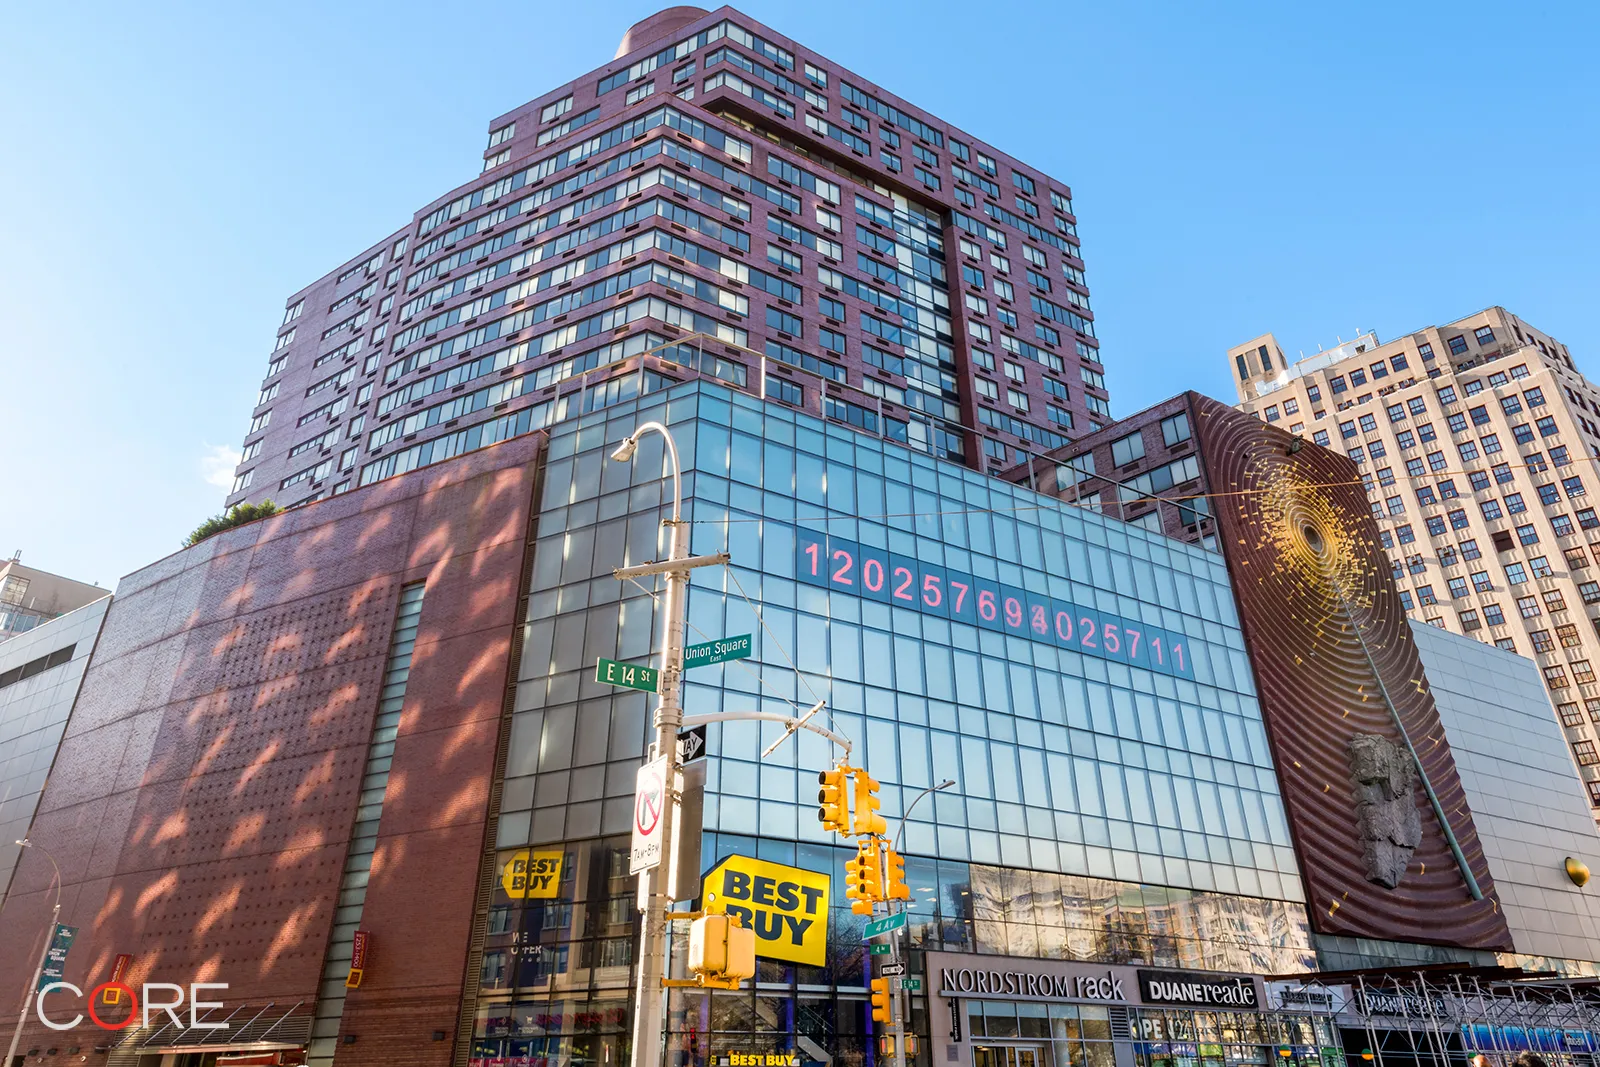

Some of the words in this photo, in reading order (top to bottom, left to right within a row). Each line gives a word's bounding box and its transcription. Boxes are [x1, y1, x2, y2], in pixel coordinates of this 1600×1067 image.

[685, 645, 711, 661] Union
[714, 638, 749, 656] Square
[709, 655, 722, 663] East
[606, 663, 616, 682] E
[621, 666, 635, 685] 14
[641, 669, 651, 683] St
[634, 843, 660, 862] 7AM-8PM
[512, 858, 560, 874] BEST
[511, 875, 553, 890] BUY
[722, 868, 824, 915] BEST
[726, 903, 814, 947] BUY
[876, 922, 882, 932] 4
[884, 920, 895, 930] Av
[903, 980, 907, 988] E
[908, 980, 914, 988] 14
[942, 967, 1071, 997] NORDSTROM
[1075, 970, 1127, 1001] rack
[730, 1054, 764, 1067] BEST
[766, 1054, 796, 1067] BUY
